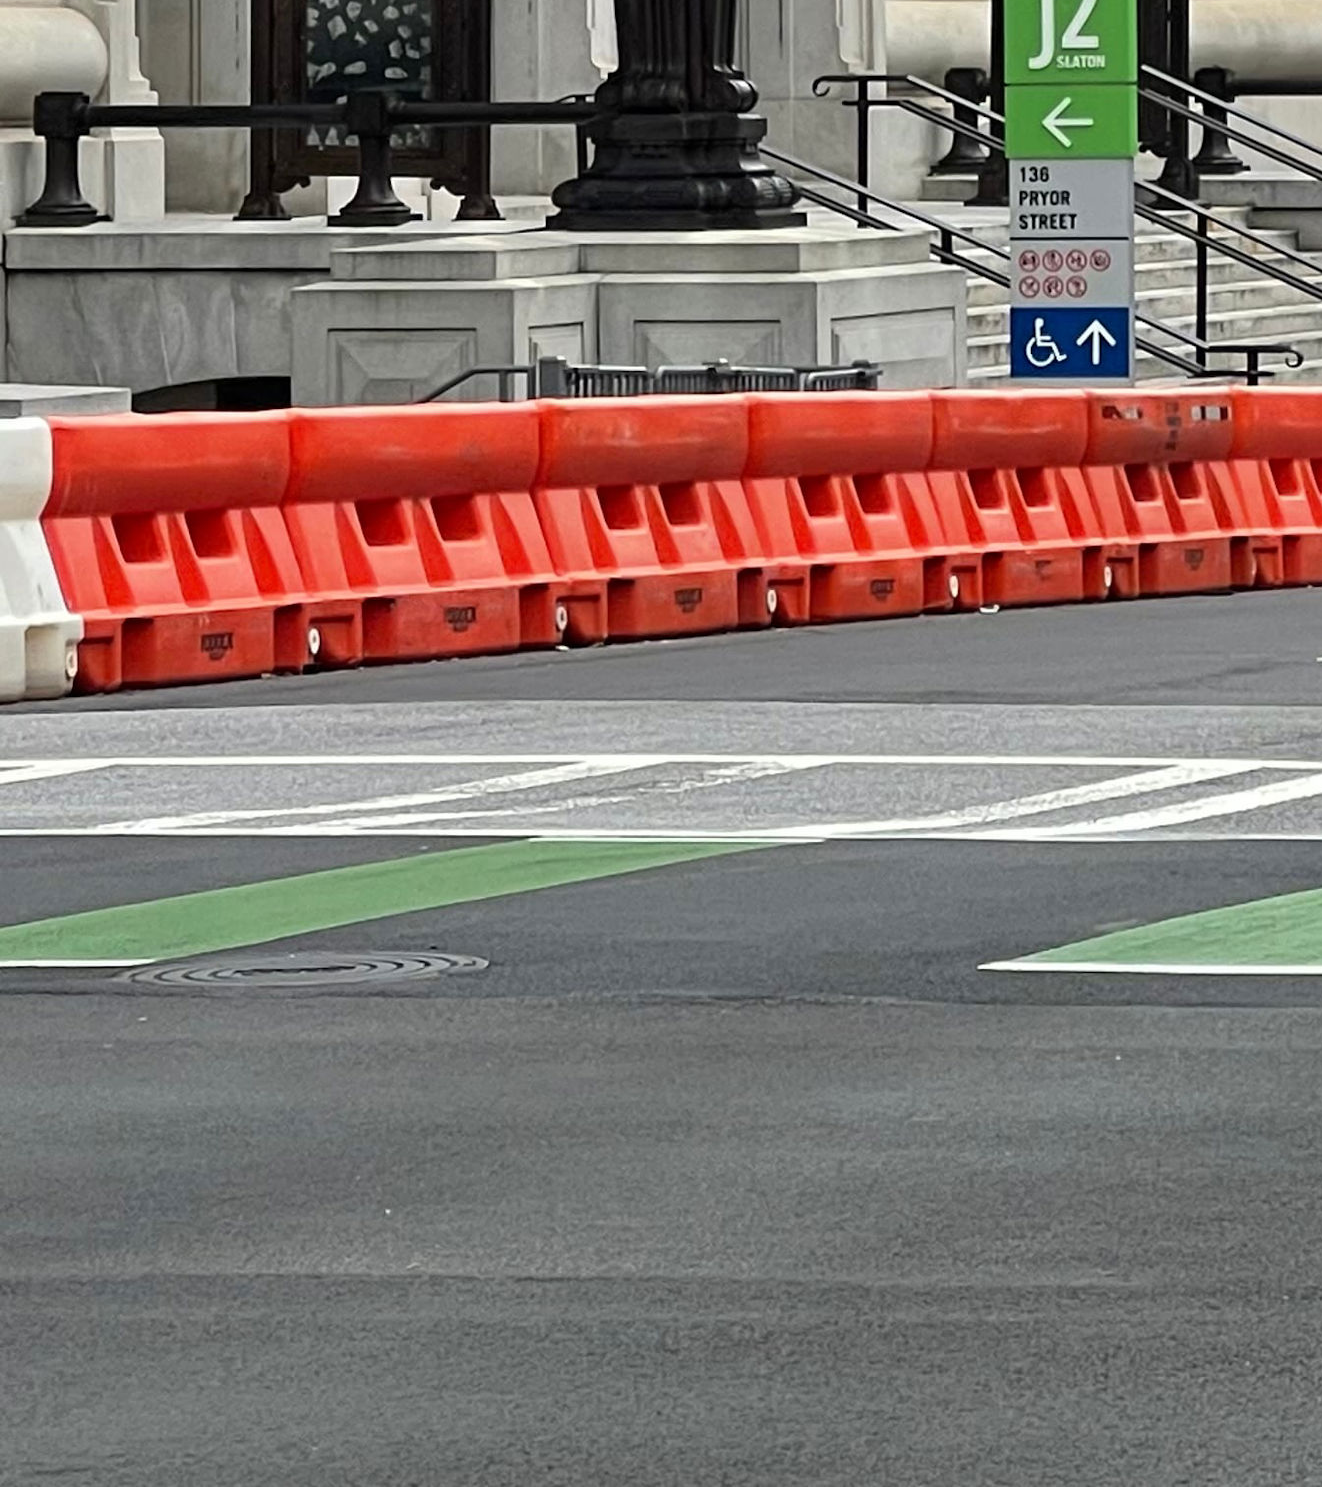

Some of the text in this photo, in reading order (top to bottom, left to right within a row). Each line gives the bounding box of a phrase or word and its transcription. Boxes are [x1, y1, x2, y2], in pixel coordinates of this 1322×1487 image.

[1056, 55, 1105, 69] SLATON
[1020, 166, 1050, 183] 136
[1019, 190, 1071, 206] PRYOR
[1019, 213, 1077, 230] STREET
